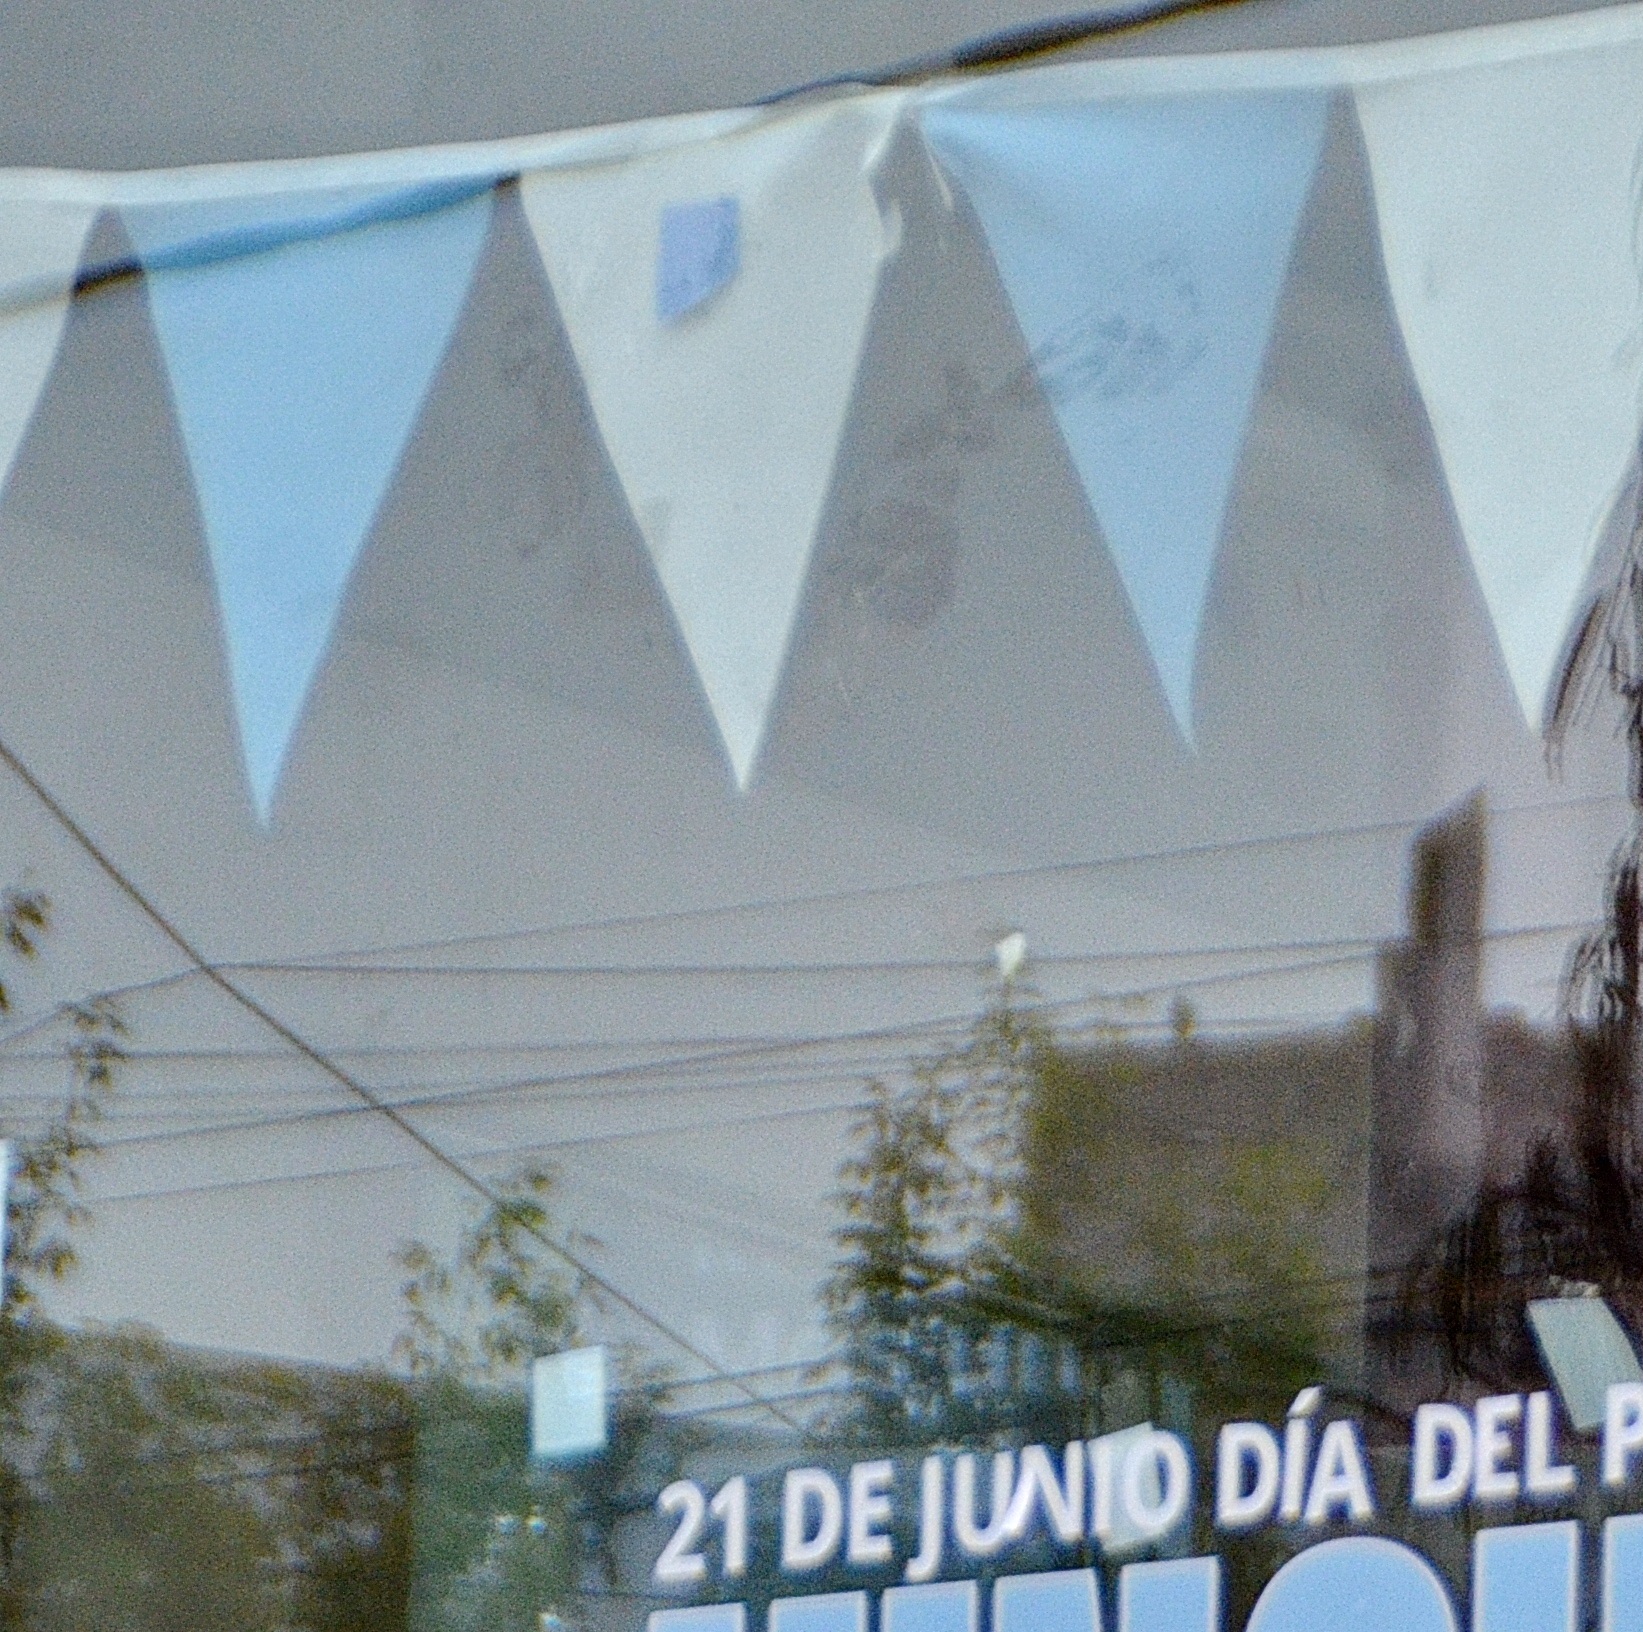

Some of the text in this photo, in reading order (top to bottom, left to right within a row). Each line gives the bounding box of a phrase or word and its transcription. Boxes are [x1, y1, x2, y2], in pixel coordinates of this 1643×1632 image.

[656, 1475, 750, 1582] 21
[780, 1456, 896, 1570] DE
[904, 1428, 1193, 1583] JUNIO
[1214, 1385, 1376, 1528] DÍA
[1411, 1388, 1577, 1506] DEL
